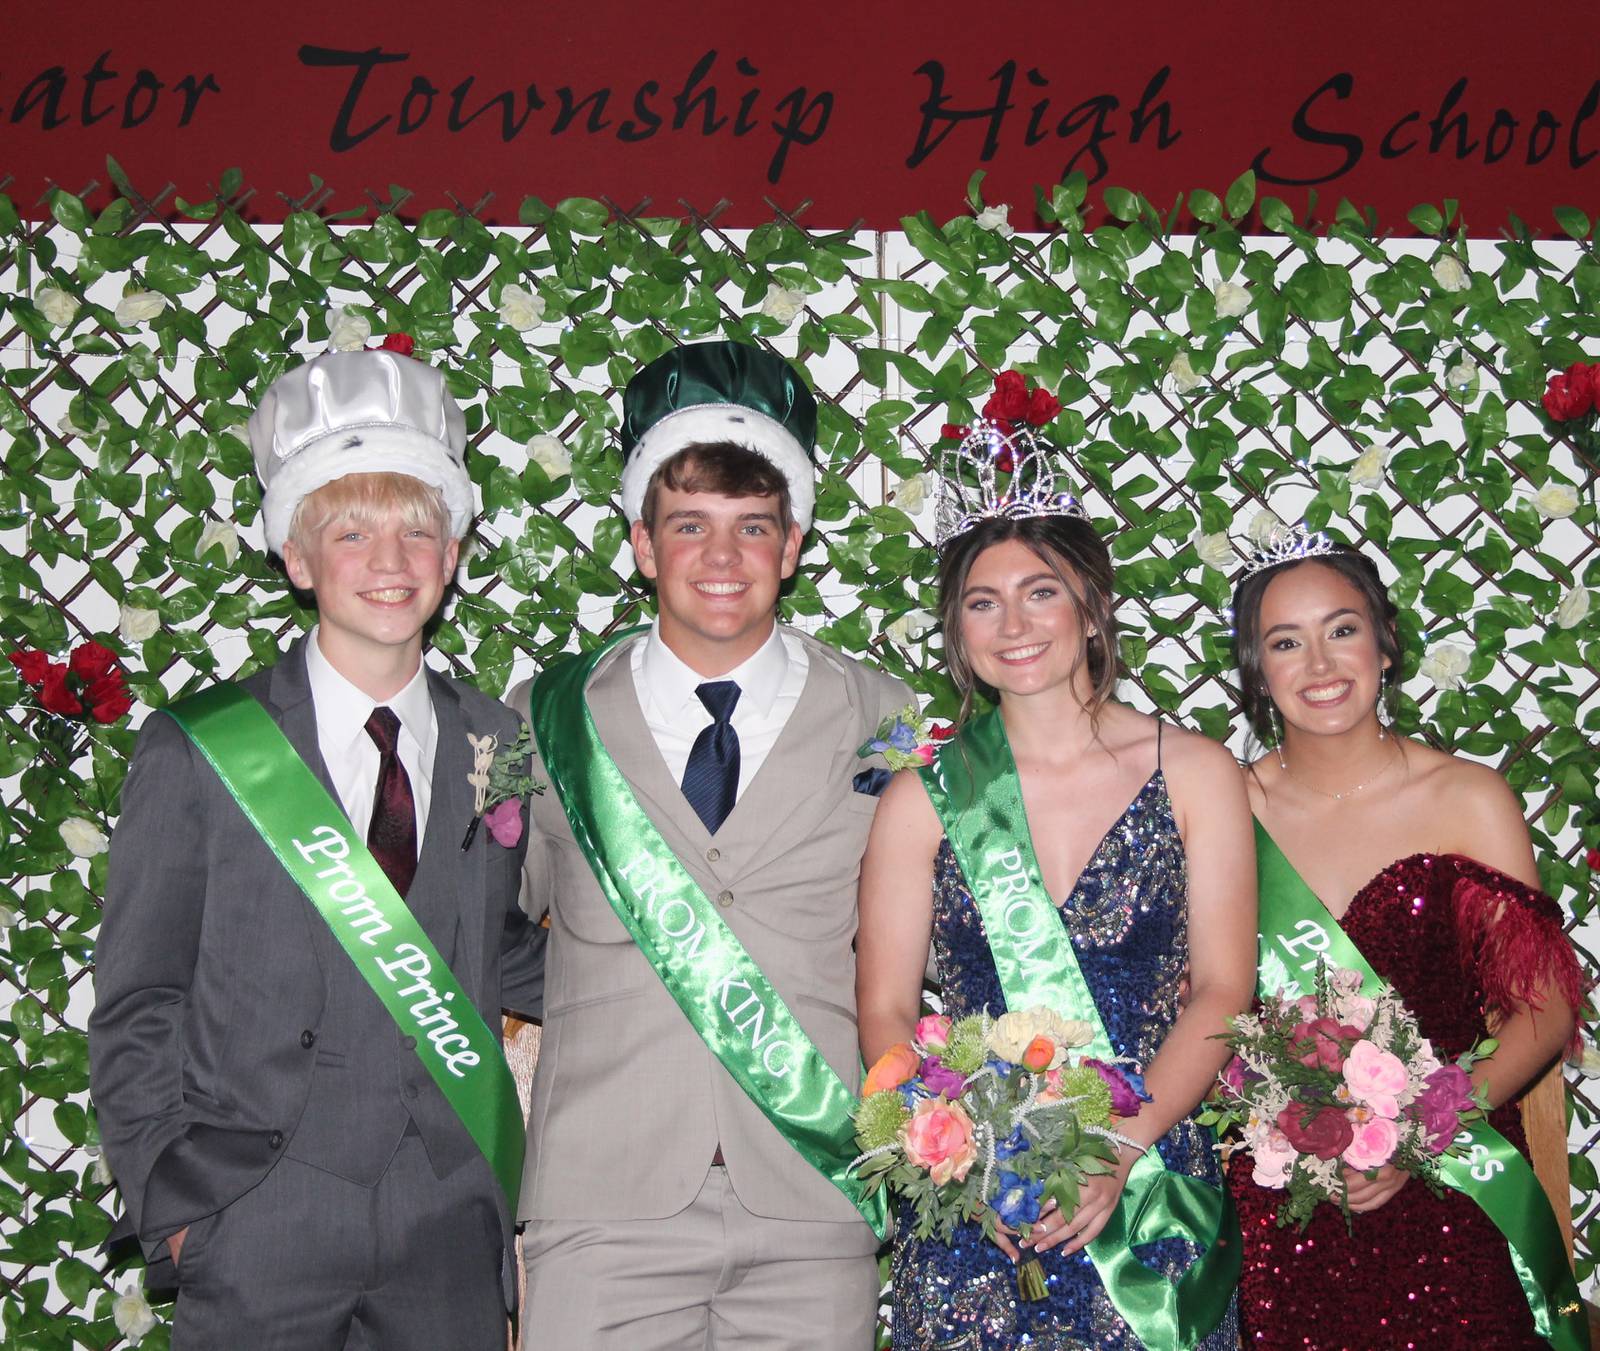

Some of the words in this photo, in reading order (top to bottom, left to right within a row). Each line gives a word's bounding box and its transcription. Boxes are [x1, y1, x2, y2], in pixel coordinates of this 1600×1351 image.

[0, 50, 221, 131] ator
[298, 45, 834, 184] Township
[905, 59, 1183, 186] High
[1248, 72, 1600, 187] School
[292, 825, 393, 946] Prom
[374, 943, 481, 1078] Prince
[617, 849, 728, 974] PROM
[708, 966, 798, 1078] KING
[989, 846, 1060, 981] PROM
